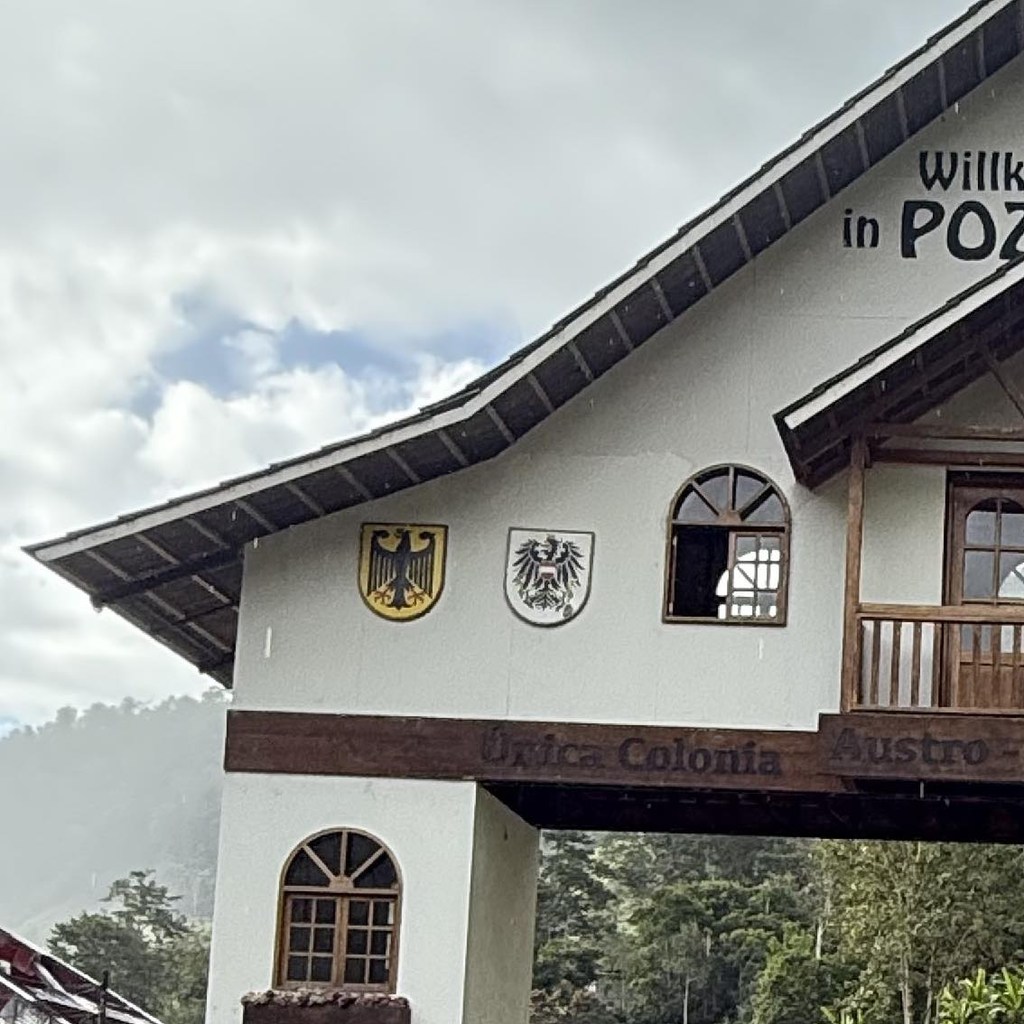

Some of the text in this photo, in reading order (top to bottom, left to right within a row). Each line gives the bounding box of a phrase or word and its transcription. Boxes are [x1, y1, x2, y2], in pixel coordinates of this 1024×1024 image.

[843, 208, 880, 248] in
[618, 737, 782, 776] Colonia
[830, 727, 989, 766] Austro
